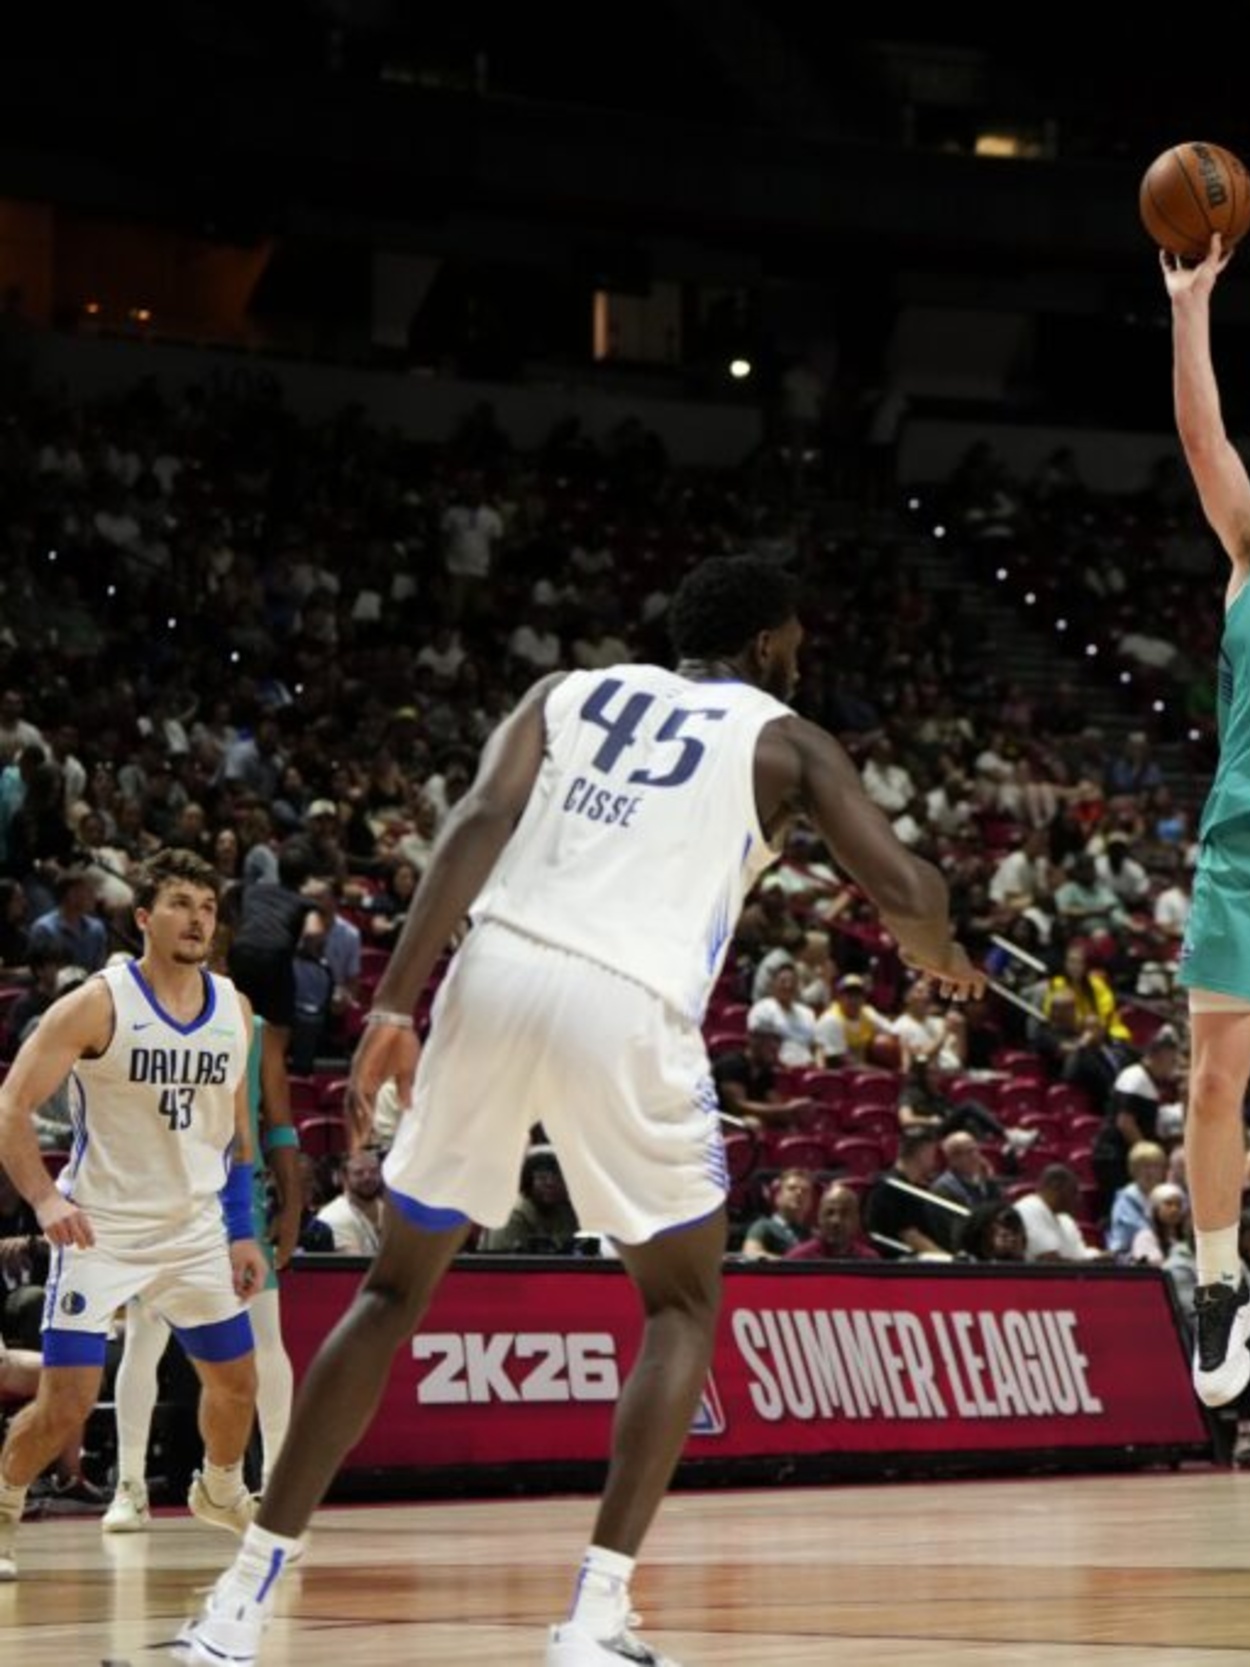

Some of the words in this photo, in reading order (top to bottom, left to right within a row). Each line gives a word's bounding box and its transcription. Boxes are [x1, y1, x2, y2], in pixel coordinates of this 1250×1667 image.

[580, 678, 729, 788] 45
[563, 776, 644, 828] CISSE
[128, 1048, 230, 1086] DALLAS
[158, 1087, 196, 1131] 43
[412, 1333, 621, 1403] 2K26
[731, 1308, 950, 1421] SUMMER
[931, 1310, 1103, 1418] LEAGUE
